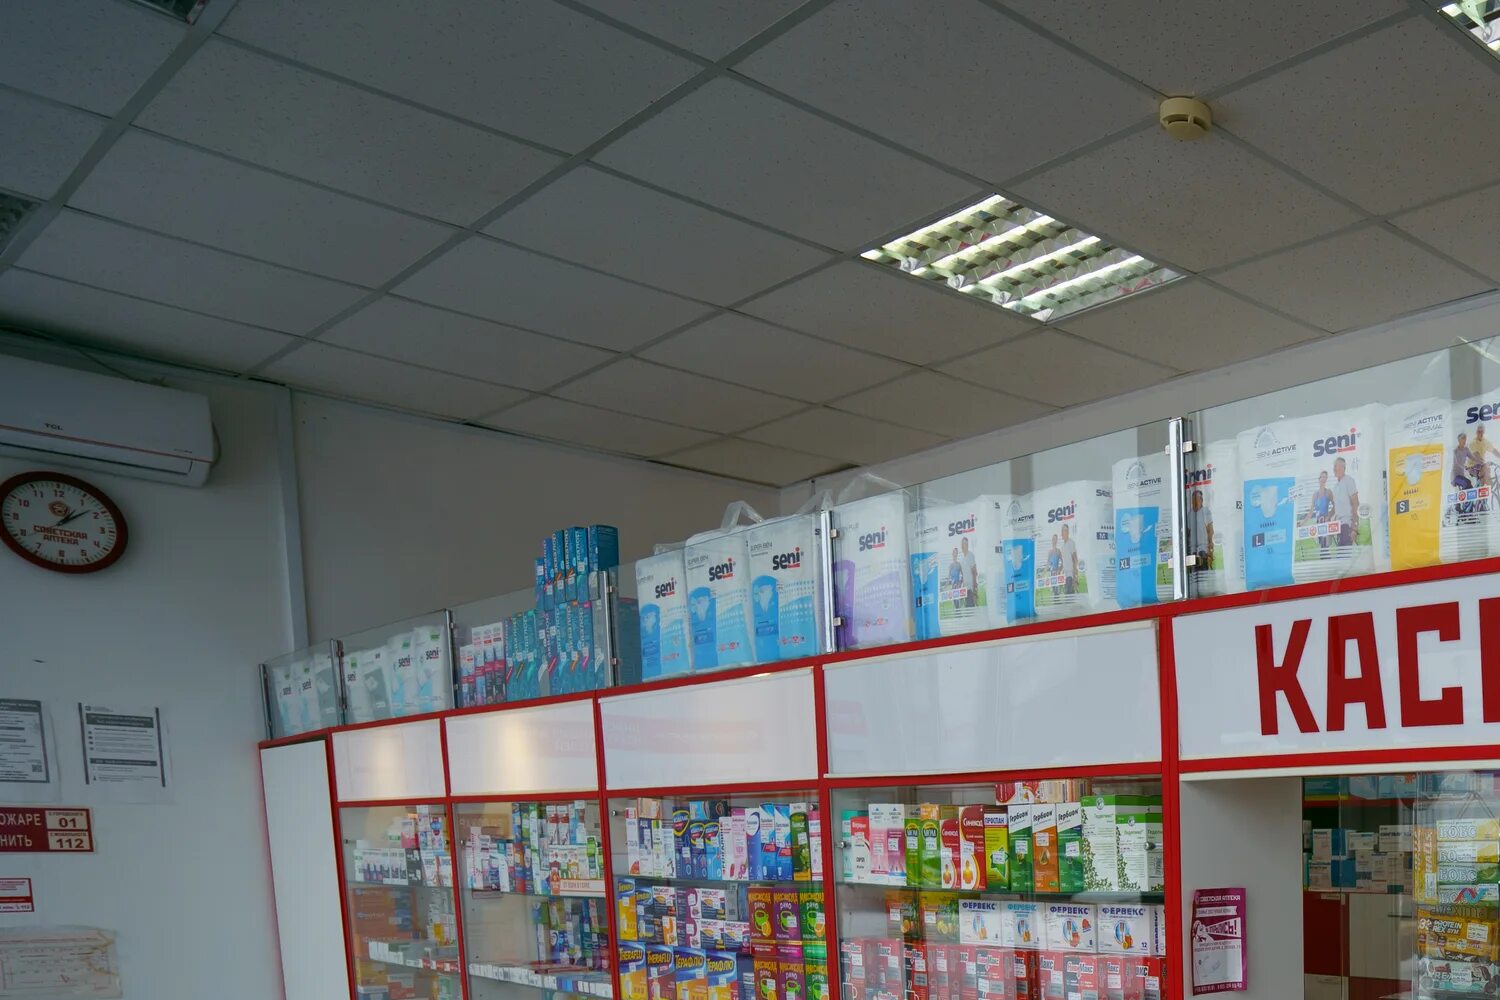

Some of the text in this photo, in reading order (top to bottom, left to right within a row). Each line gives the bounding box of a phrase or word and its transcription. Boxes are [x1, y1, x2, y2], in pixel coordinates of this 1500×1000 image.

[1312, 427, 1357, 457] seni
[1048, 500, 1076, 523] seni
[33, 525, 87, 539] СОВЕТСКАЯ
[948, 513, 976, 537] seni
[43, 534, 79, 545] АПТЕКА
[859, 526, 886, 552] seni
[772, 547, 801, 572] seni
[709, 558, 734, 582] seni
[655, 576, 676, 600] seni
[59, 818, 77, 827] 01
[57, 839, 84, 848] 112
[962, 901, 998, 910] ФЕРВЕКС
[1050, 907, 1090, 917] ФЕРВЕКС
[1102, 907, 1145, 917] ФЕРВЕКС
